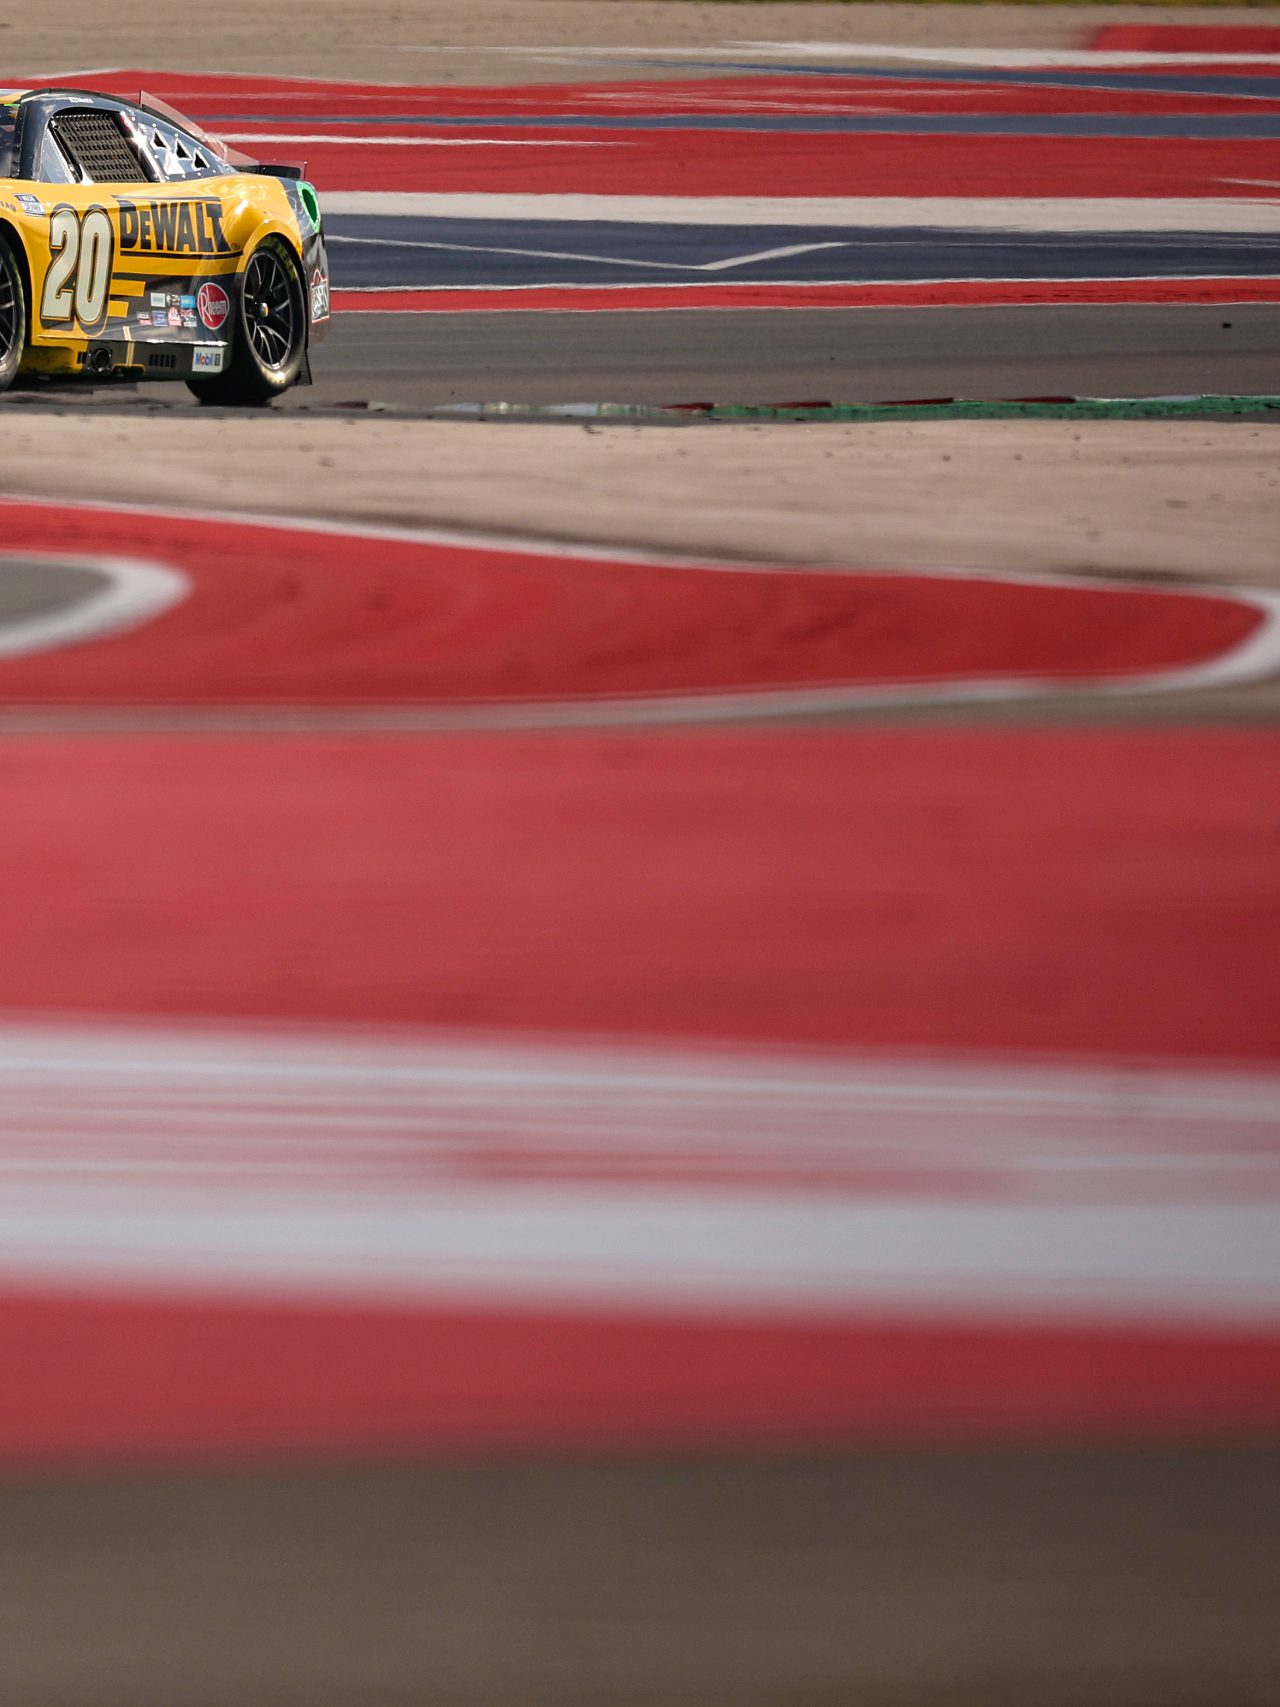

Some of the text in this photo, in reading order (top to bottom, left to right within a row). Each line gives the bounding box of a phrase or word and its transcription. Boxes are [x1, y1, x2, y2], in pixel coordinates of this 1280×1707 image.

[41, 206, 112, 324] 20
[199, 284, 227, 322] Rheem
[195, 352, 214, 366] Mobil
